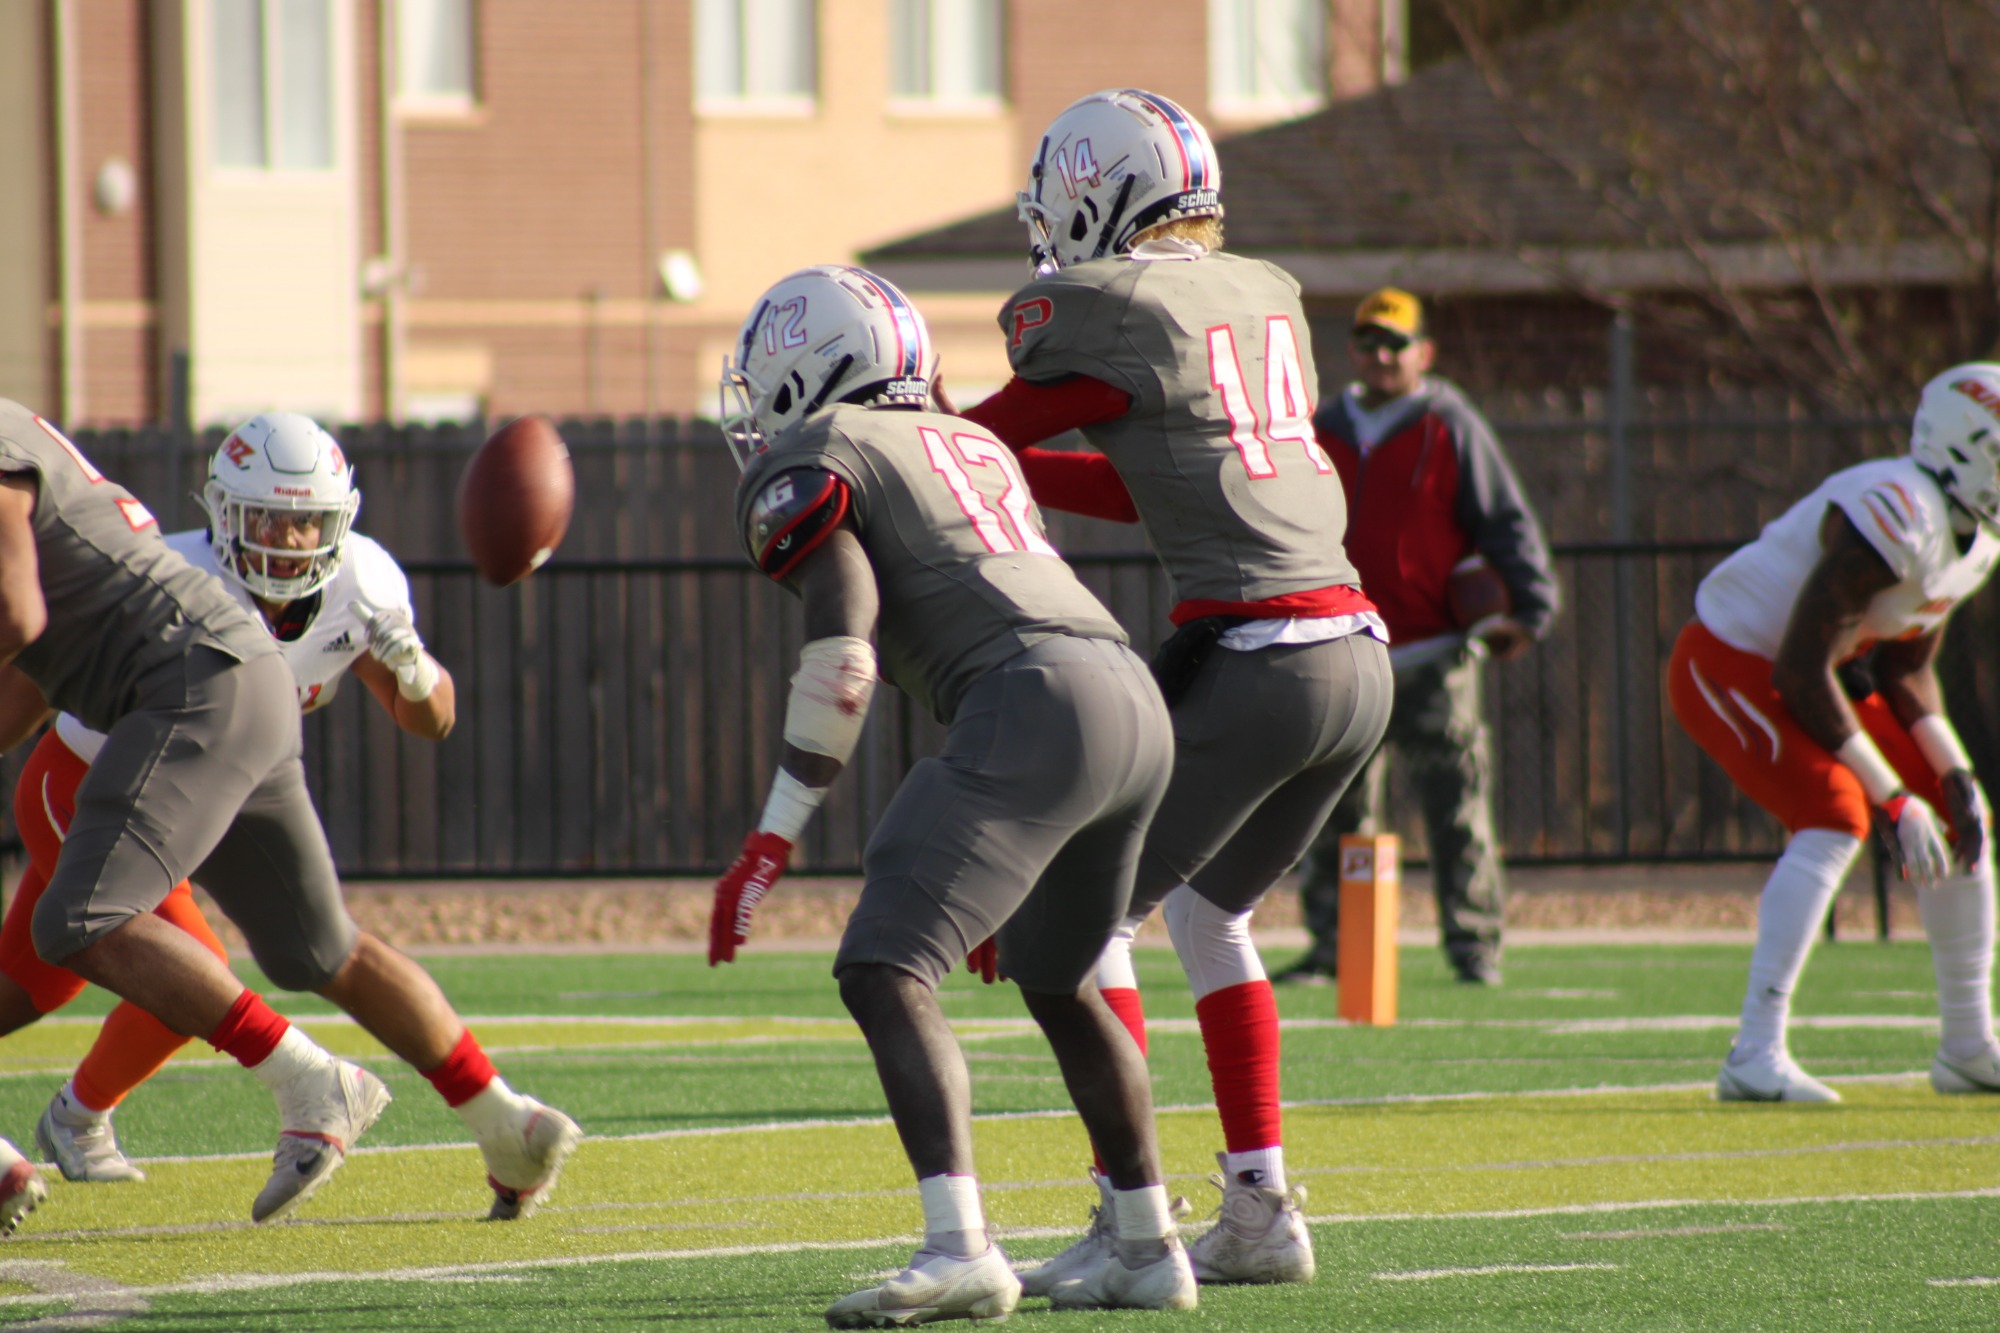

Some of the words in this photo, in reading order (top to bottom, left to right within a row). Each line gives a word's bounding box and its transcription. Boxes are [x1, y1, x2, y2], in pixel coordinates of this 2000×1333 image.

[1057, 138, 1101, 199] 14
[765, 296, 807, 356] 12
[1013, 296, 1053, 348] P
[1205, 314, 1332, 480] 14
[917, 426, 1062, 557] 12
